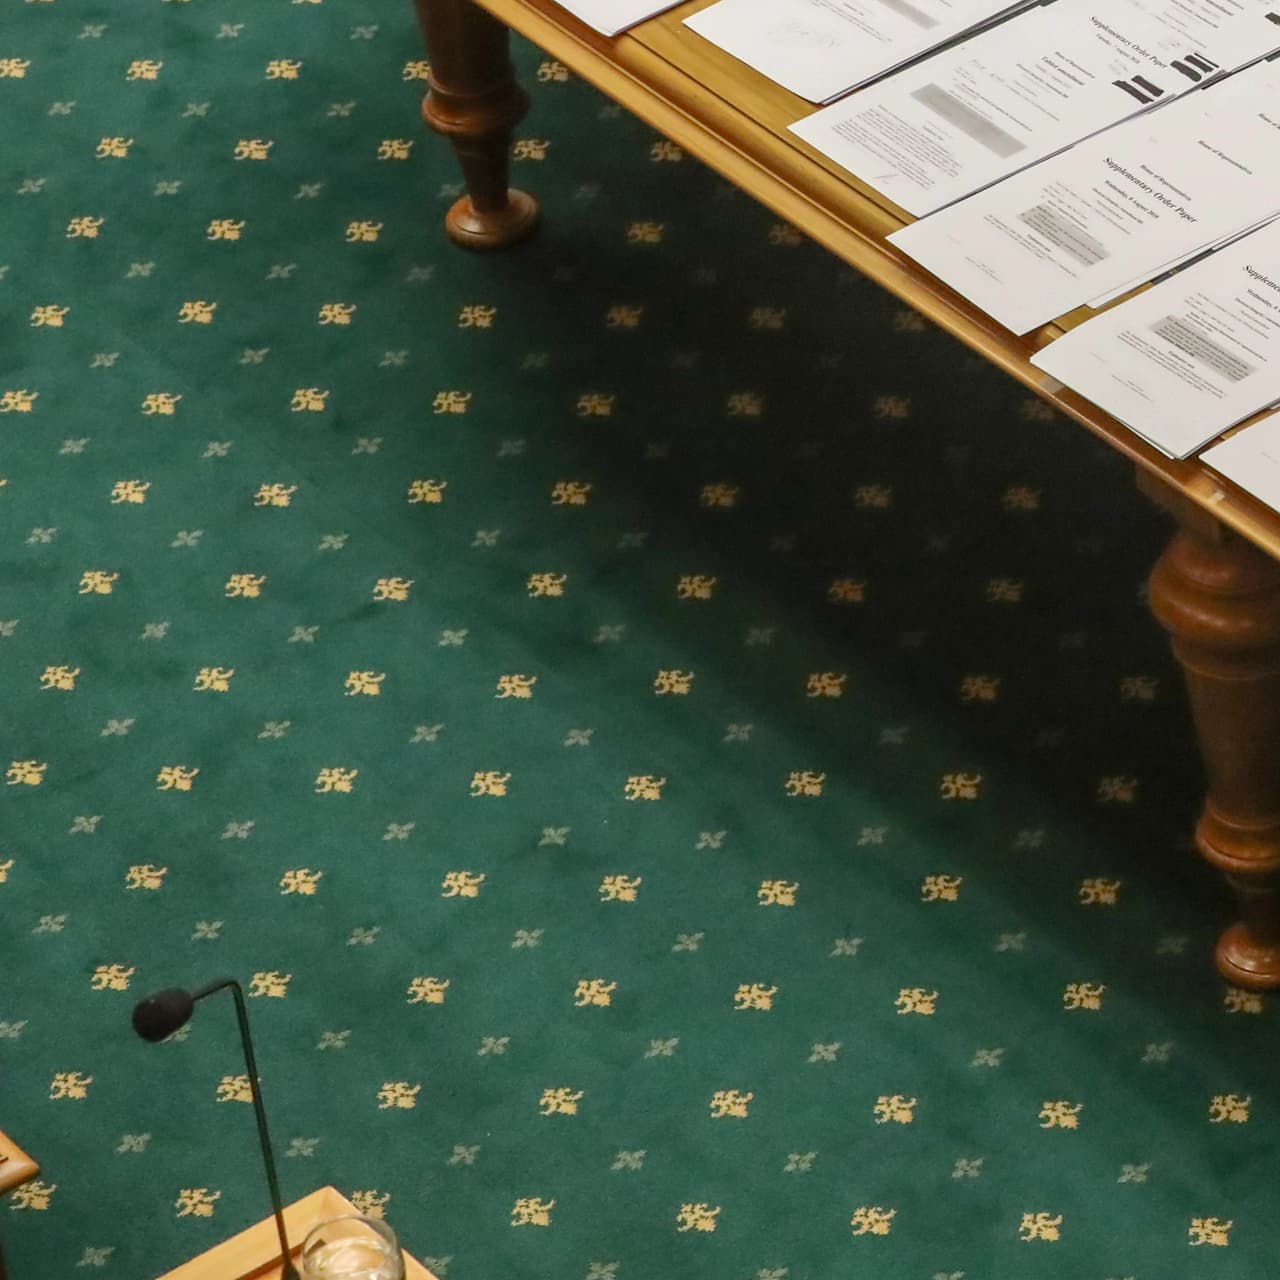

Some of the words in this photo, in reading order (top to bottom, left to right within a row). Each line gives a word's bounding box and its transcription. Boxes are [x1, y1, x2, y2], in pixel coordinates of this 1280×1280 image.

[1102, 157, 1153, 194] Supplementary
[1154, 192, 1177, 210] Order
[1175, 207, 1198, 224] Paper
